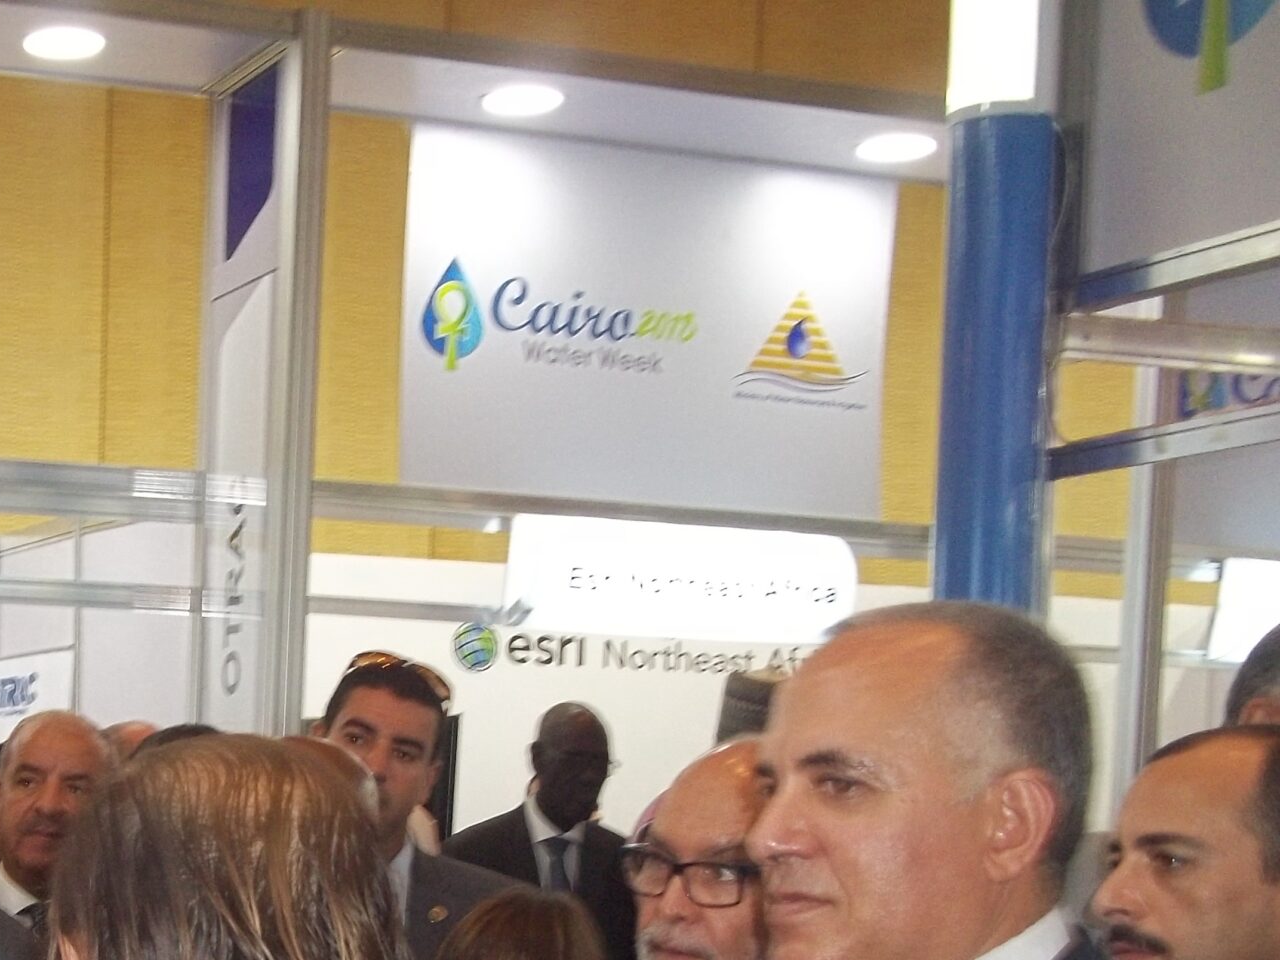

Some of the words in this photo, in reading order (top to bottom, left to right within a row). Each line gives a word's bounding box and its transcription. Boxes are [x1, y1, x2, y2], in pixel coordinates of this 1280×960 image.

[492, 277, 635, 342] Cairo
[521, 340, 594, 367] Water
[598, 346, 665, 374] Week
[602, 637, 757, 675] Northeast
